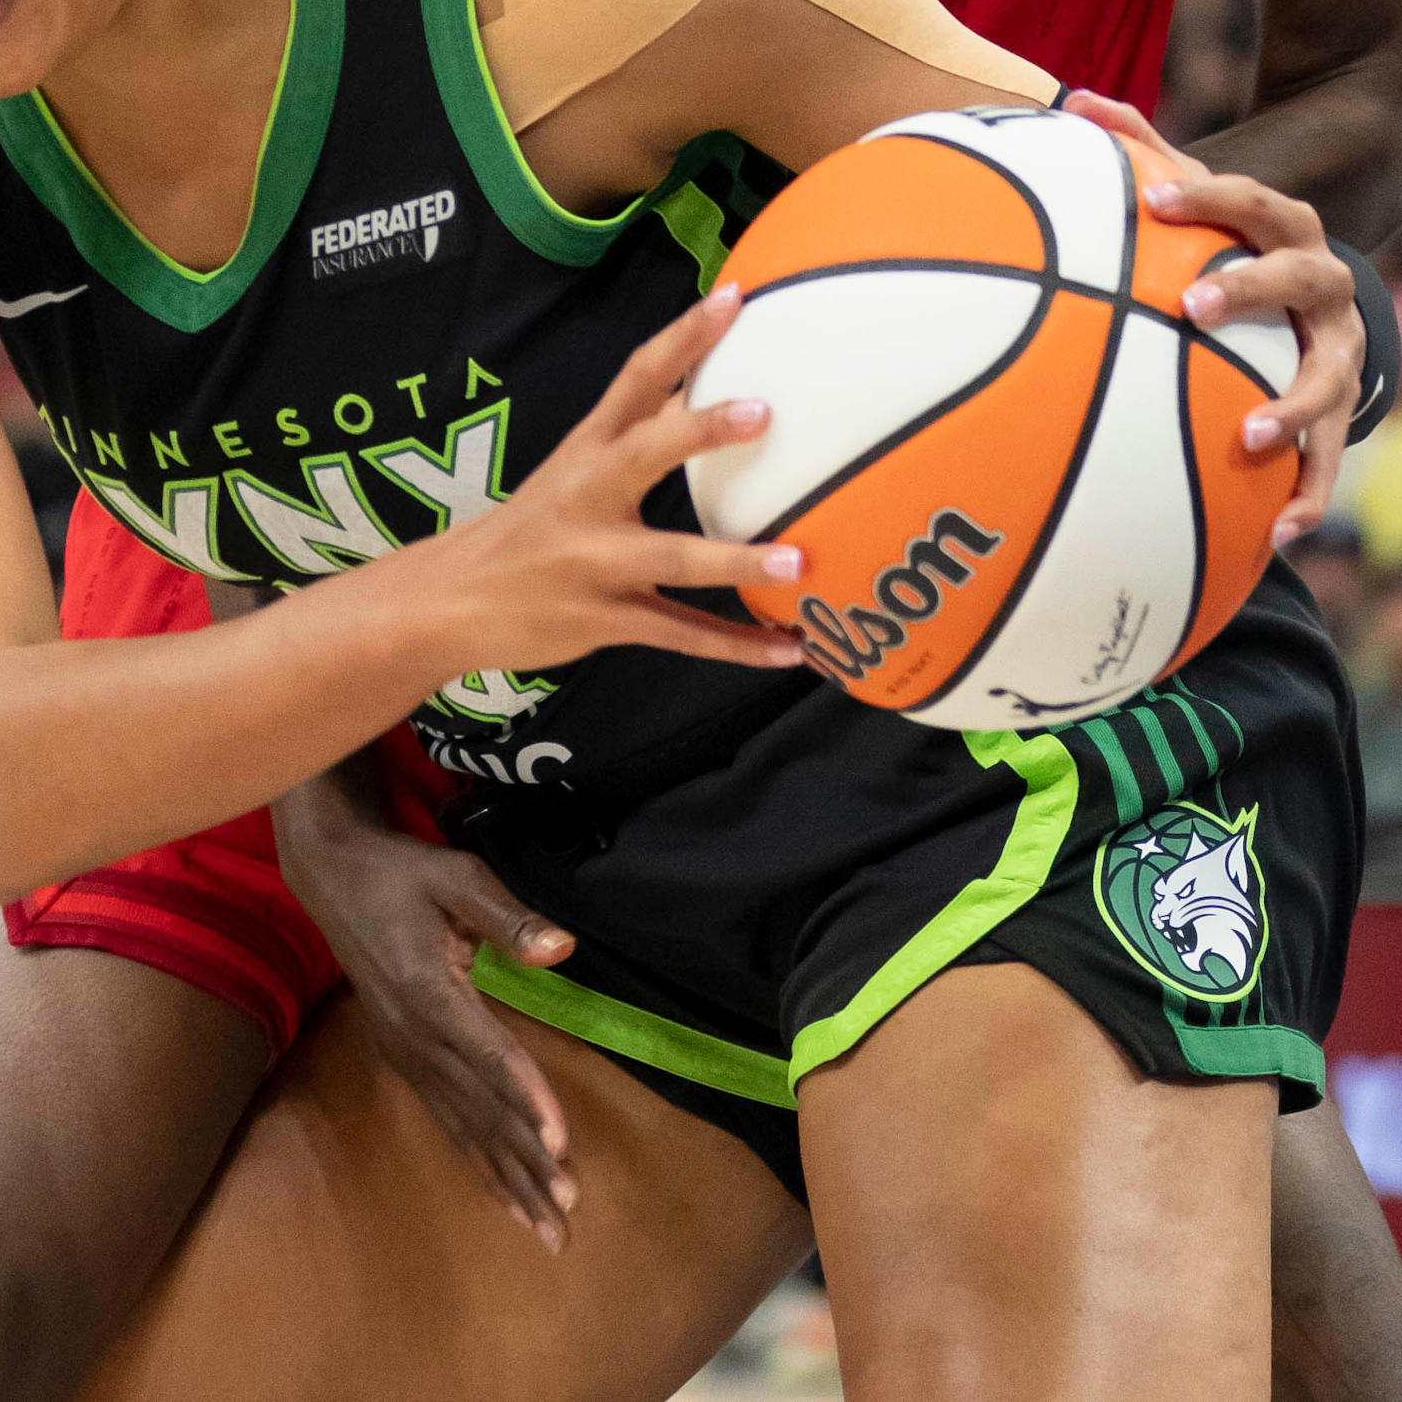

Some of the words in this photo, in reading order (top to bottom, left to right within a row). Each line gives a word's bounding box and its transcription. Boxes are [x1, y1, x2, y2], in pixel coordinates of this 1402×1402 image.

[311, 190, 455, 258] FEDERATED
[78, 397, 511, 581] YNX
[798, 506, 1007, 686] ilson
